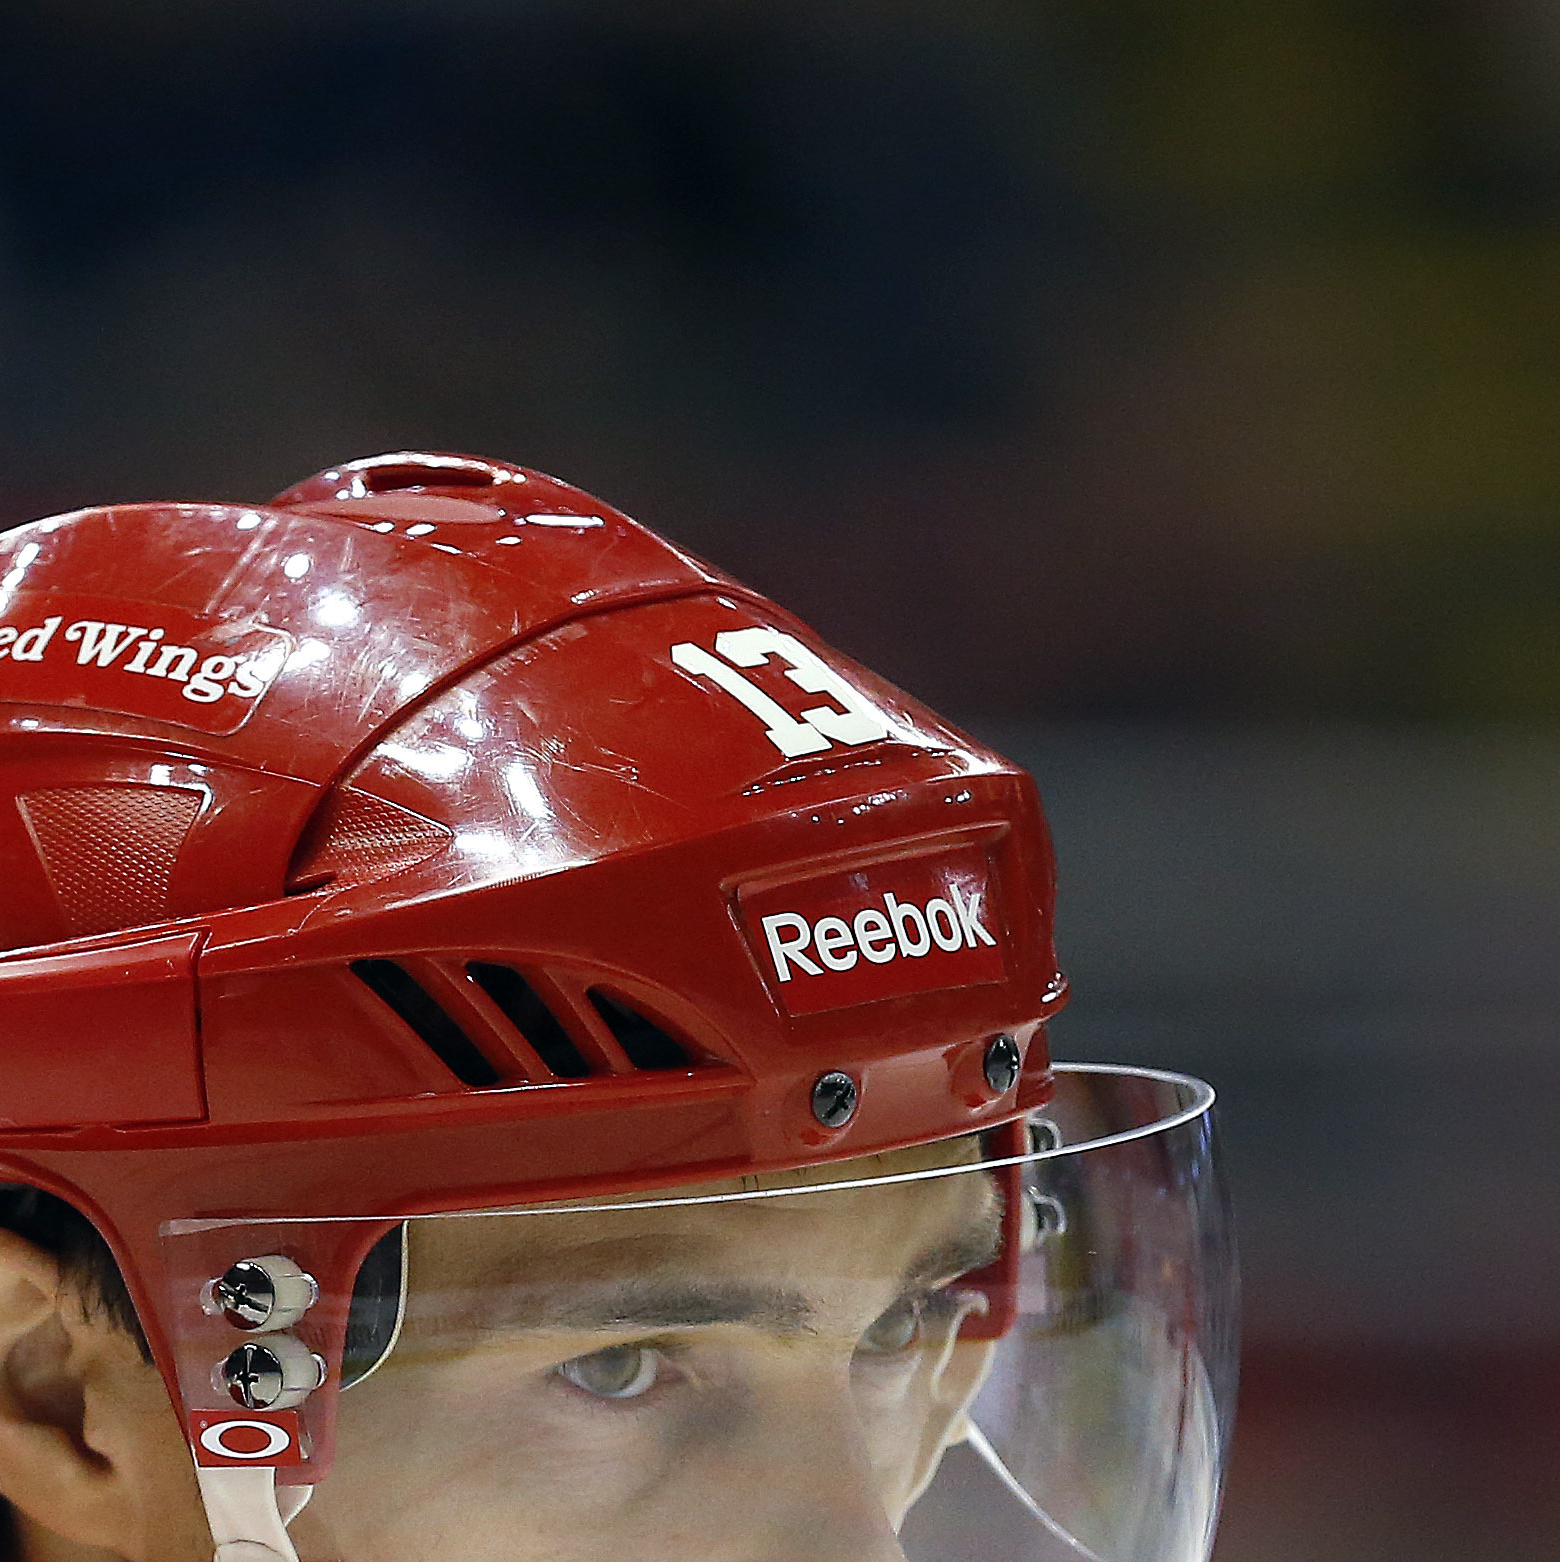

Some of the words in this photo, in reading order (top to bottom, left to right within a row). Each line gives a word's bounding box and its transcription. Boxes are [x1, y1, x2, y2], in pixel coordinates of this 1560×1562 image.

[64, 620, 269, 703] Wings
[670, 626, 892, 758] 13
[761, 884, 997, 983] Reebok
